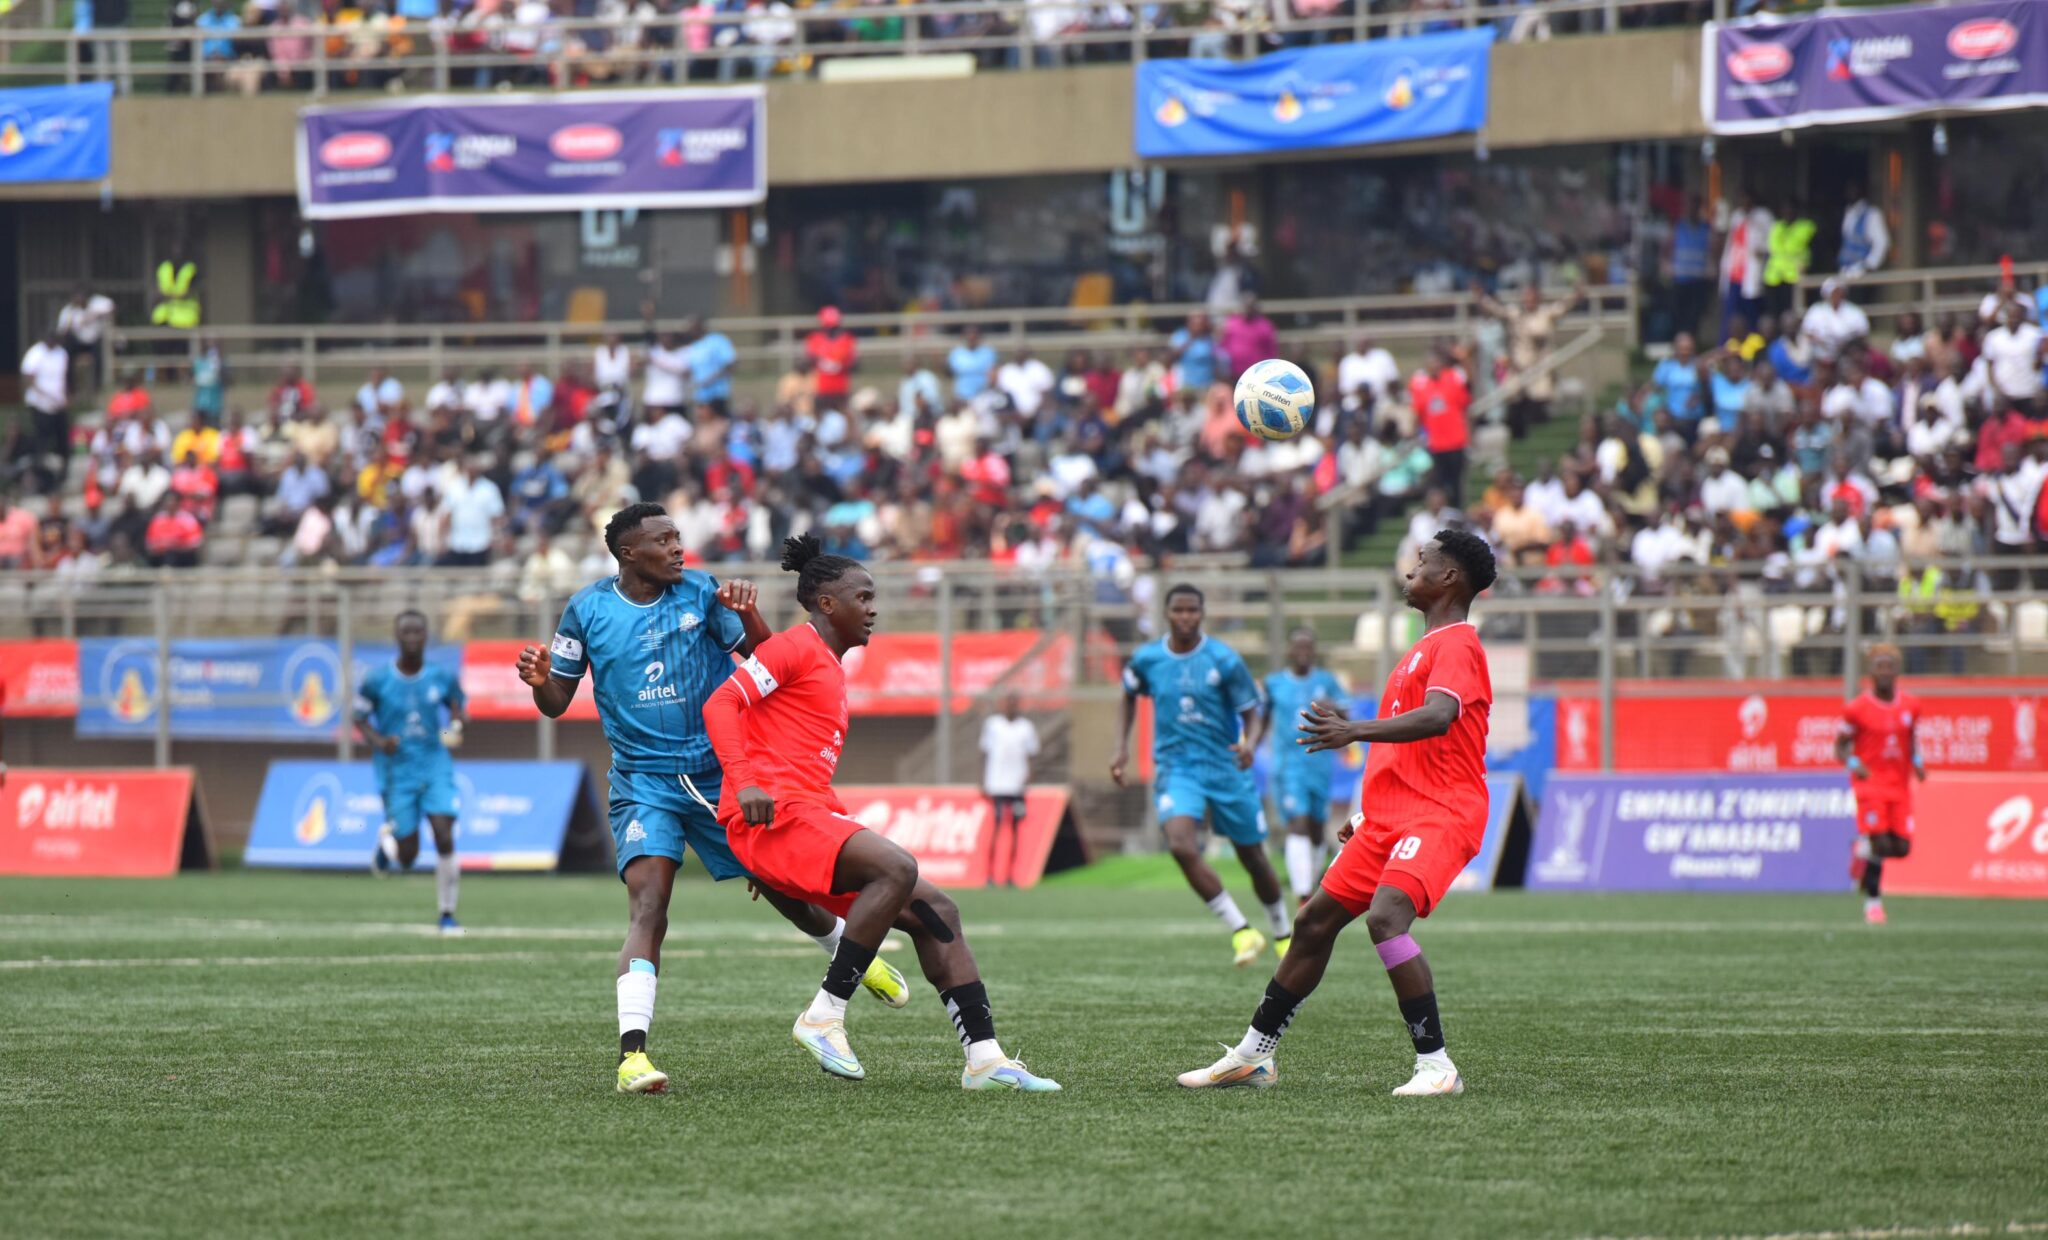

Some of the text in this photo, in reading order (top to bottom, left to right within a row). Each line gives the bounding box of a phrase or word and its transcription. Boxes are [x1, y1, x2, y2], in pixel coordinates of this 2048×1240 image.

[1262, 390, 1291, 407] molten
[638, 684, 677, 701] airtel
[44, 778, 118, 829] airtel
[1617, 789, 1715, 821] EMPAKA
[887, 797, 988, 854] airtel
